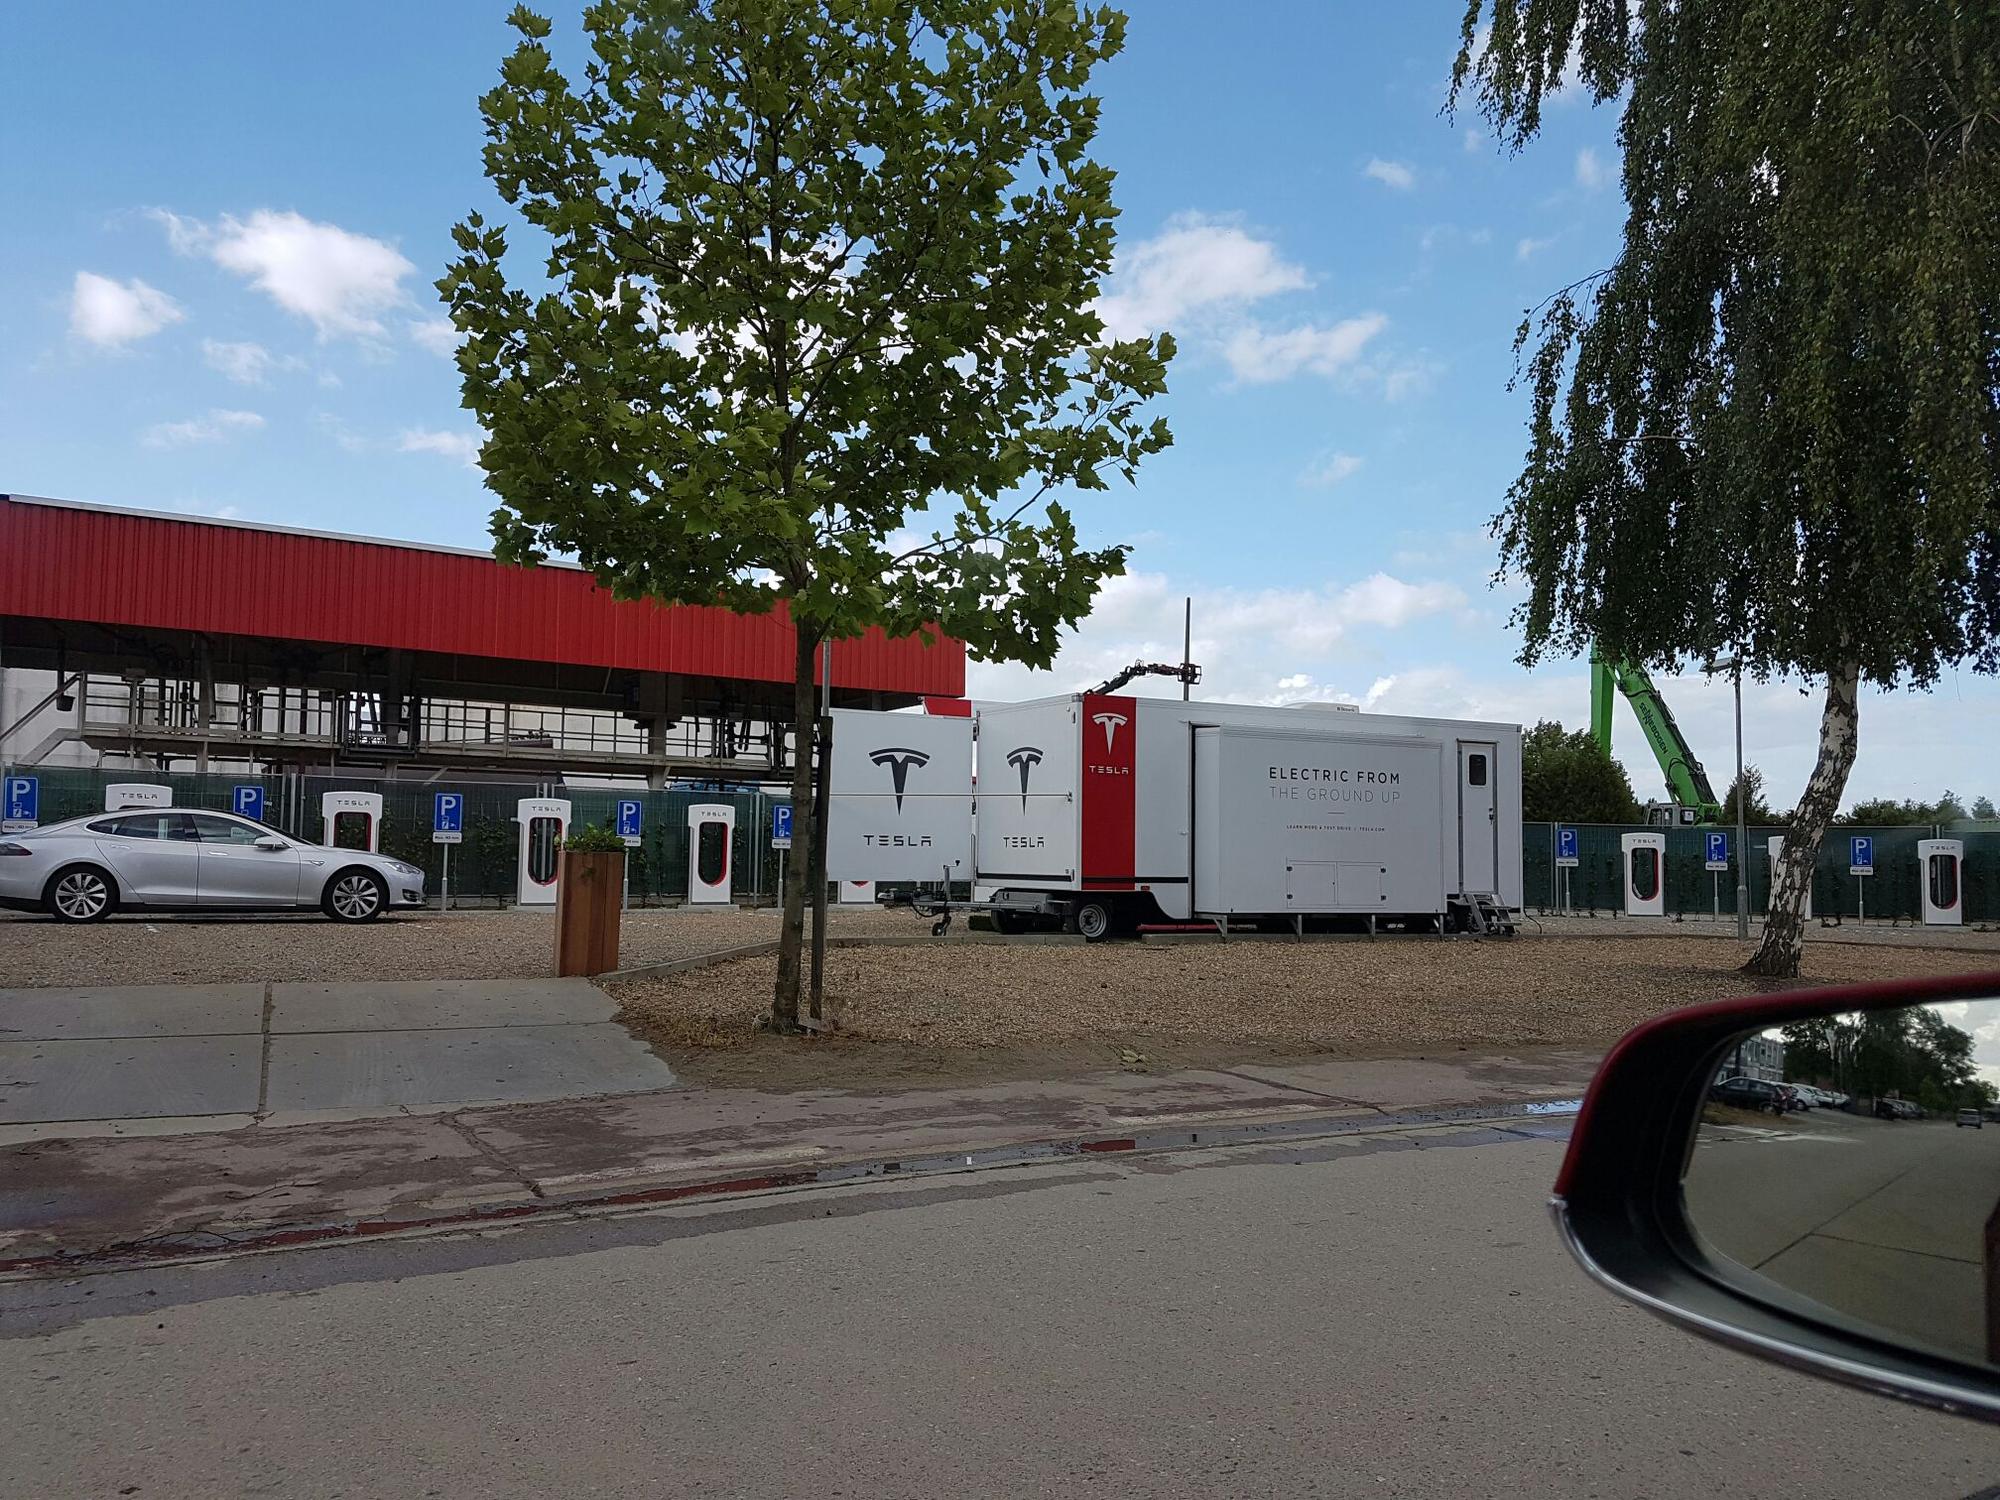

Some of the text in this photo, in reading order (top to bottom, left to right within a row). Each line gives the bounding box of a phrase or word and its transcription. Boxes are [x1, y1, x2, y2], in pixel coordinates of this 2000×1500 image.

[1088, 765, 1129, 775] TESLA
[1269, 766, 1400, 785] ELECTRIC FROM
[12, 780, 30, 802] P
[120, 792, 158, 800] TESLA
[1269, 786, 1400, 804] THE GROUND UP
[240, 788, 256, 810] P
[337, 799, 370, 807] TESLA
[441, 796, 456, 816] P
[622, 803, 636, 821] P
[778, 808, 790, 825] P
[863, 834, 932, 847] TESLA
[1003, 836, 1045, 848] TESLA
[1561, 831, 1573, 846] P
[1710, 835, 1722, 850] P
[1855, 839, 1867, 854] P
